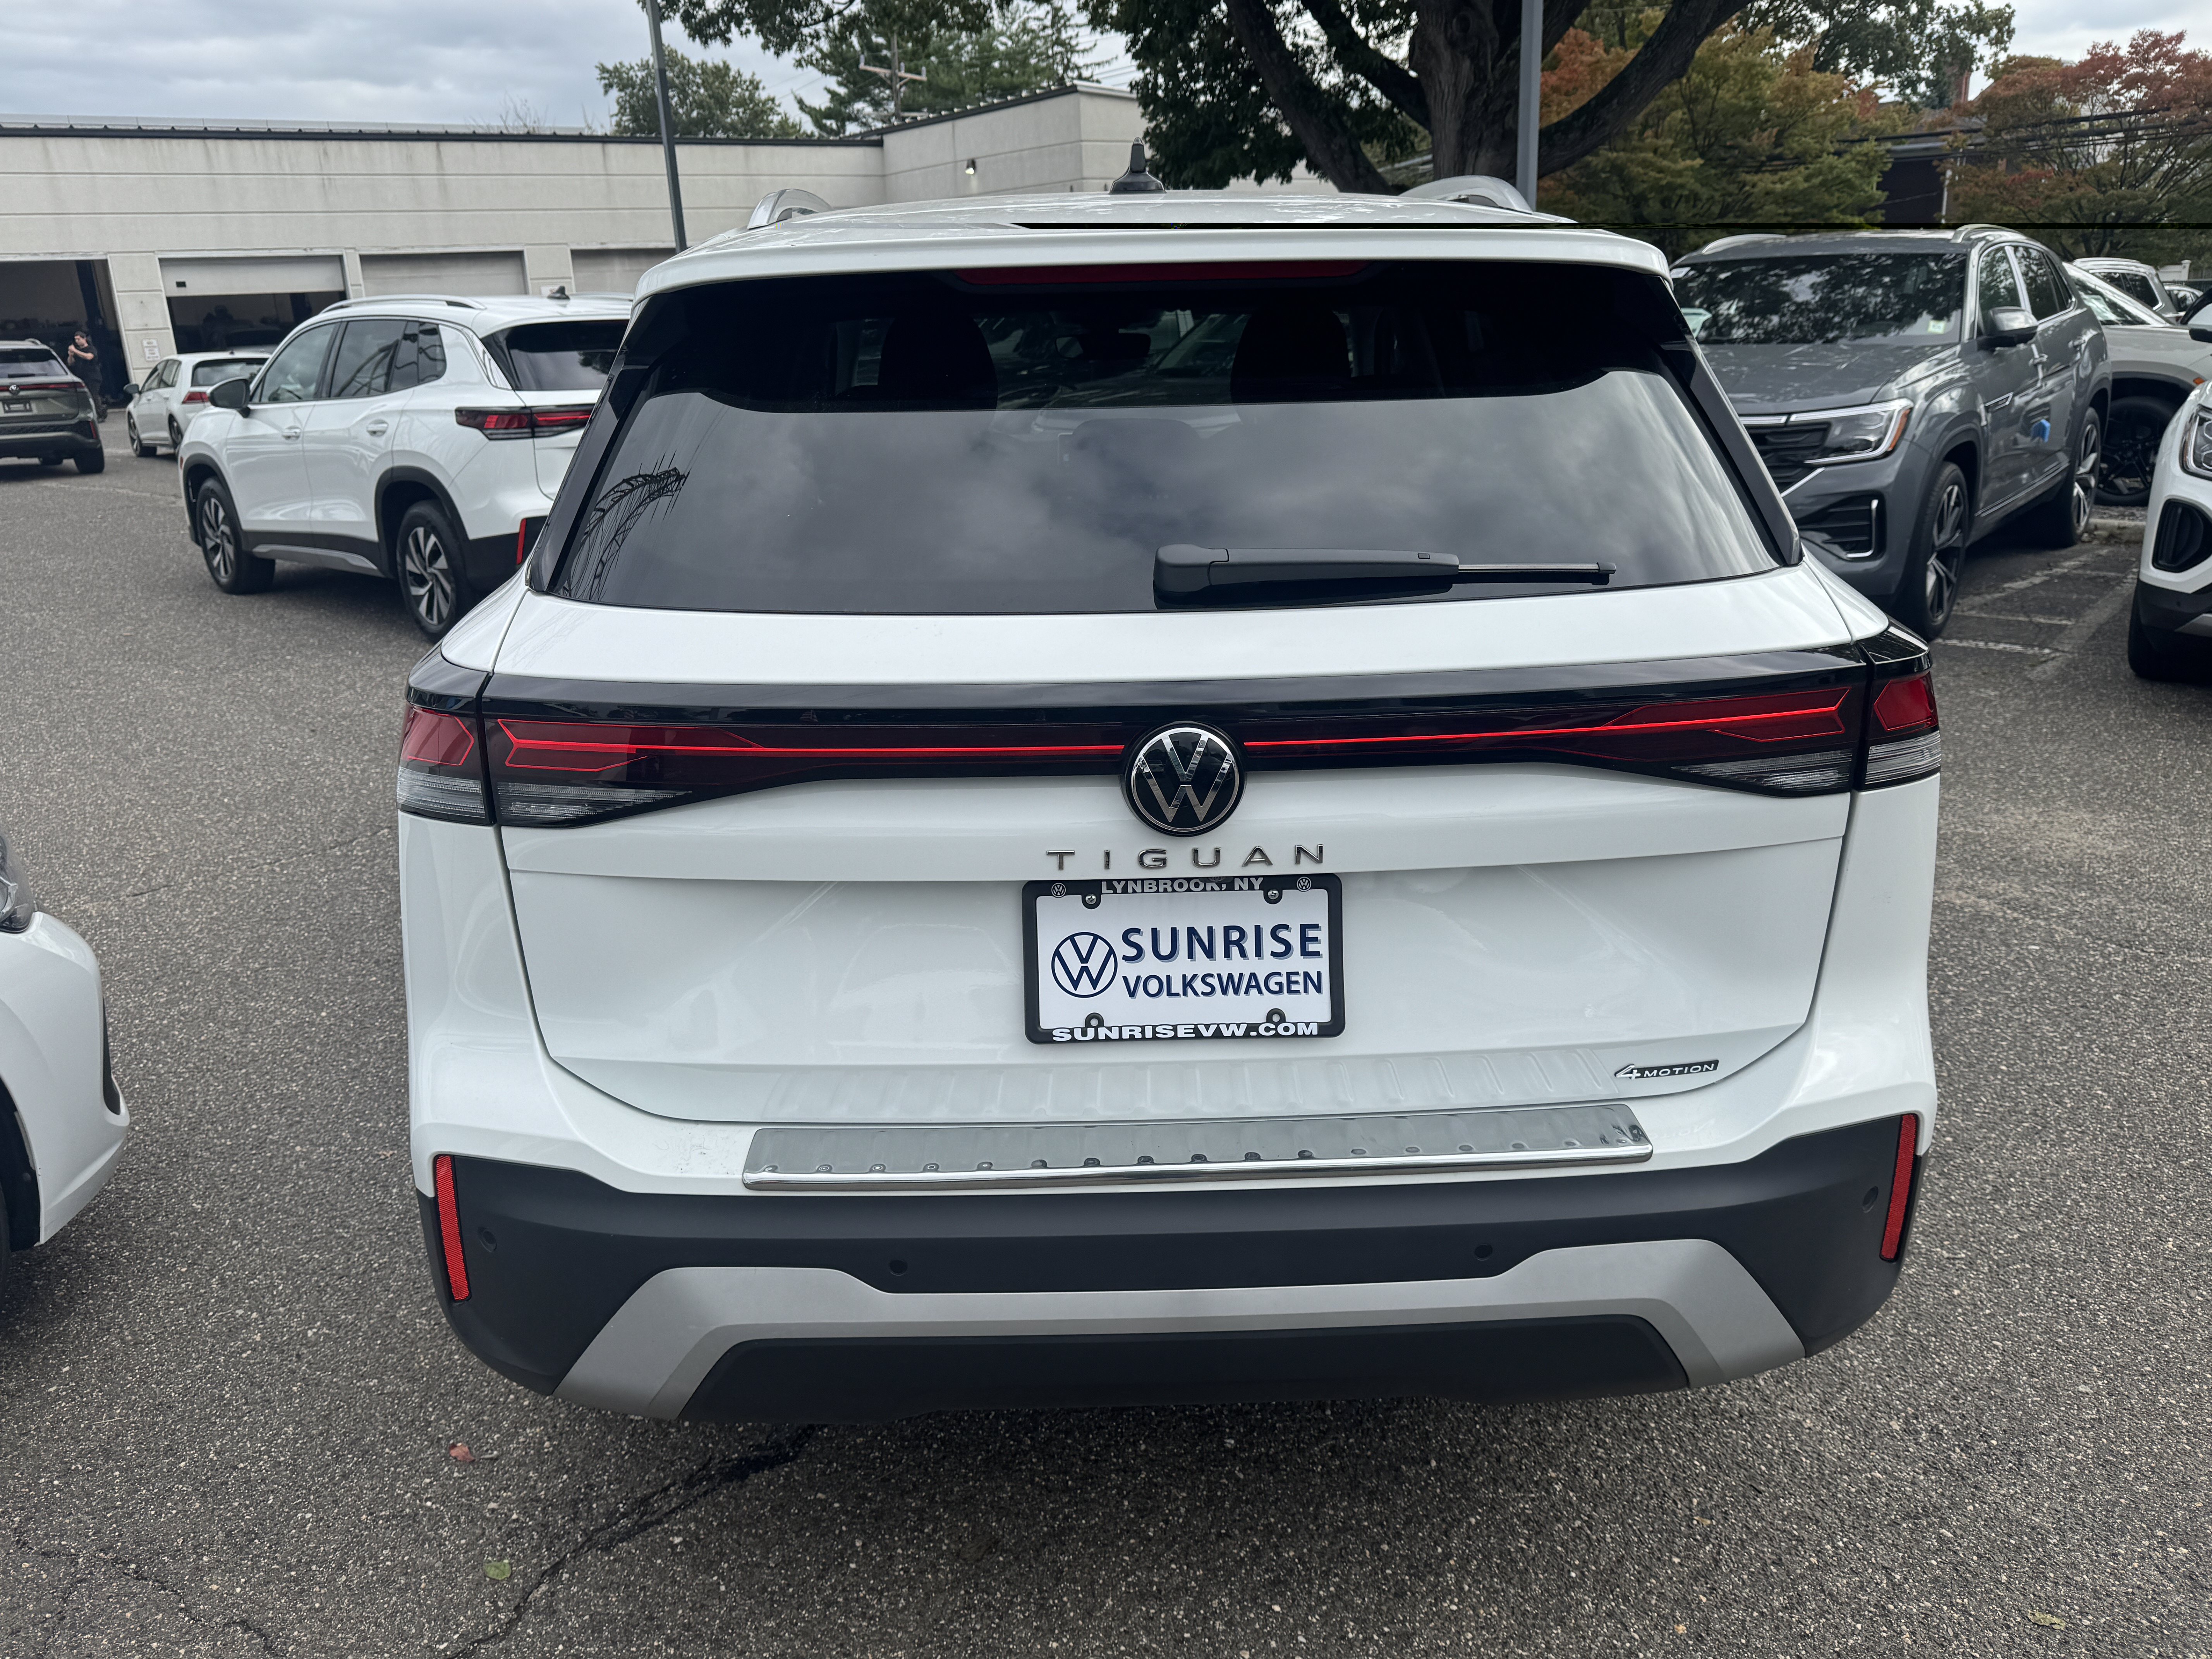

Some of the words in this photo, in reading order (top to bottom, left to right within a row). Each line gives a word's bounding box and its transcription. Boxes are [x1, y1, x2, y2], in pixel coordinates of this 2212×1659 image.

[1046, 844, 1324, 870] TIGUAN
[1101, 879, 1226, 894] LYNBROOK,
[1234, 877, 1263, 890] NY
[1121, 923, 1323, 963] SUNRISE
[1051, 932, 1118, 998] VW
[1122, 971, 1323, 998] VOLKSWAGEN
[1053, 1023, 1318, 1041] SUNRISEVW.COM
